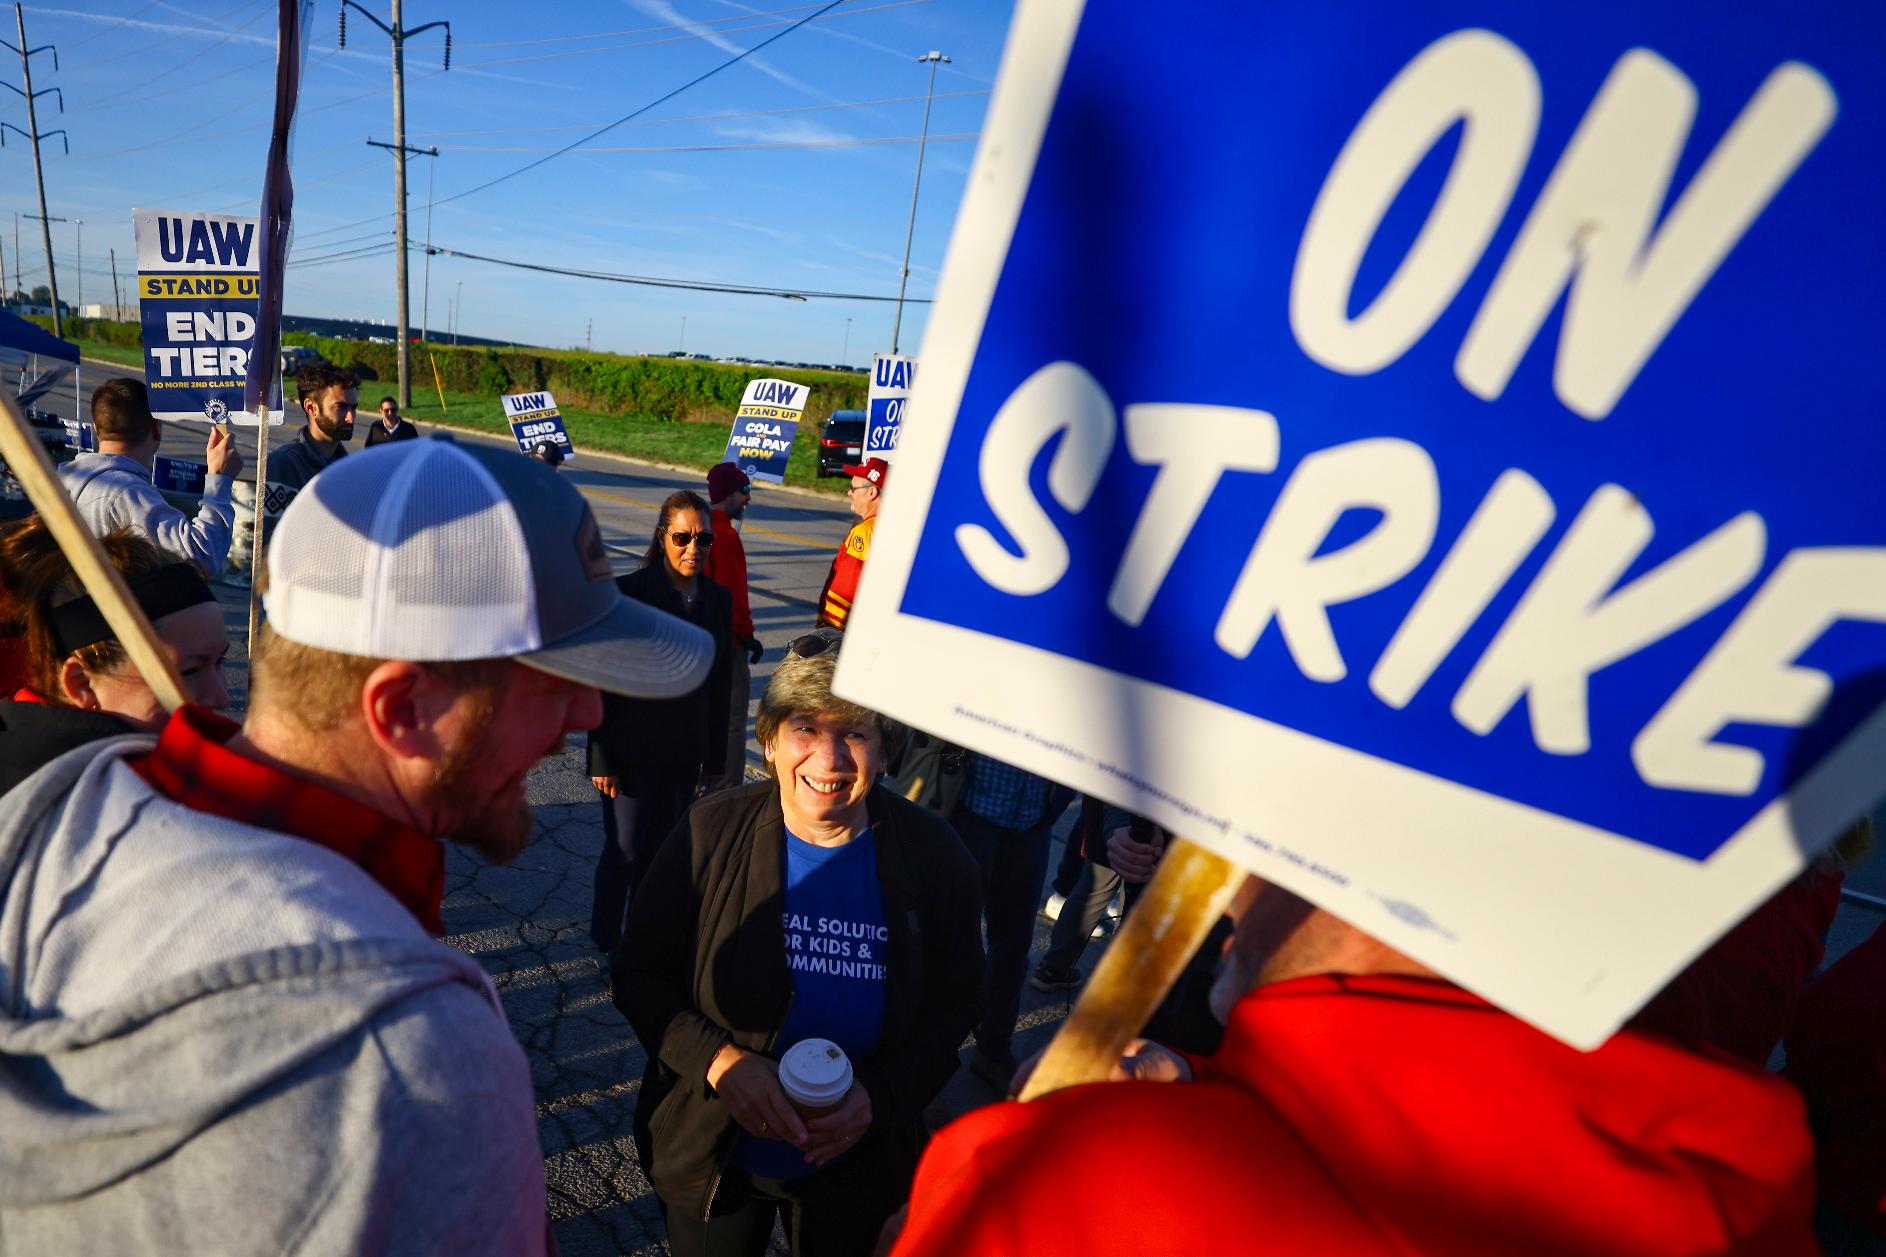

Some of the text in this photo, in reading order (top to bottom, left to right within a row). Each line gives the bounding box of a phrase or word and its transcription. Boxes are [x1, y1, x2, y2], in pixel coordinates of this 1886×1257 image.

[1288, 27, 1839, 421] ON
[158, 217, 254, 266] UAW
[147, 279, 229, 295] STAND
[166, 312, 256, 341] END
[151, 347, 253, 376] TIER
[754, 382, 798, 405] UAW
[511, 394, 545, 411] UAW
[512, 413, 542, 422] STAND
[742, 407, 778, 417] STAND
[522, 421, 556, 437] END
[746, 423, 781, 436] COLA
[731, 436, 790, 452] FAIR PAY
[739, 448, 774, 460] NOW
[867, 469, 880, 482] 16
[953, 361, 1886, 796] STRIKE
[809, 936, 851, 957] KIDS
[858, 943, 872, 959] &
